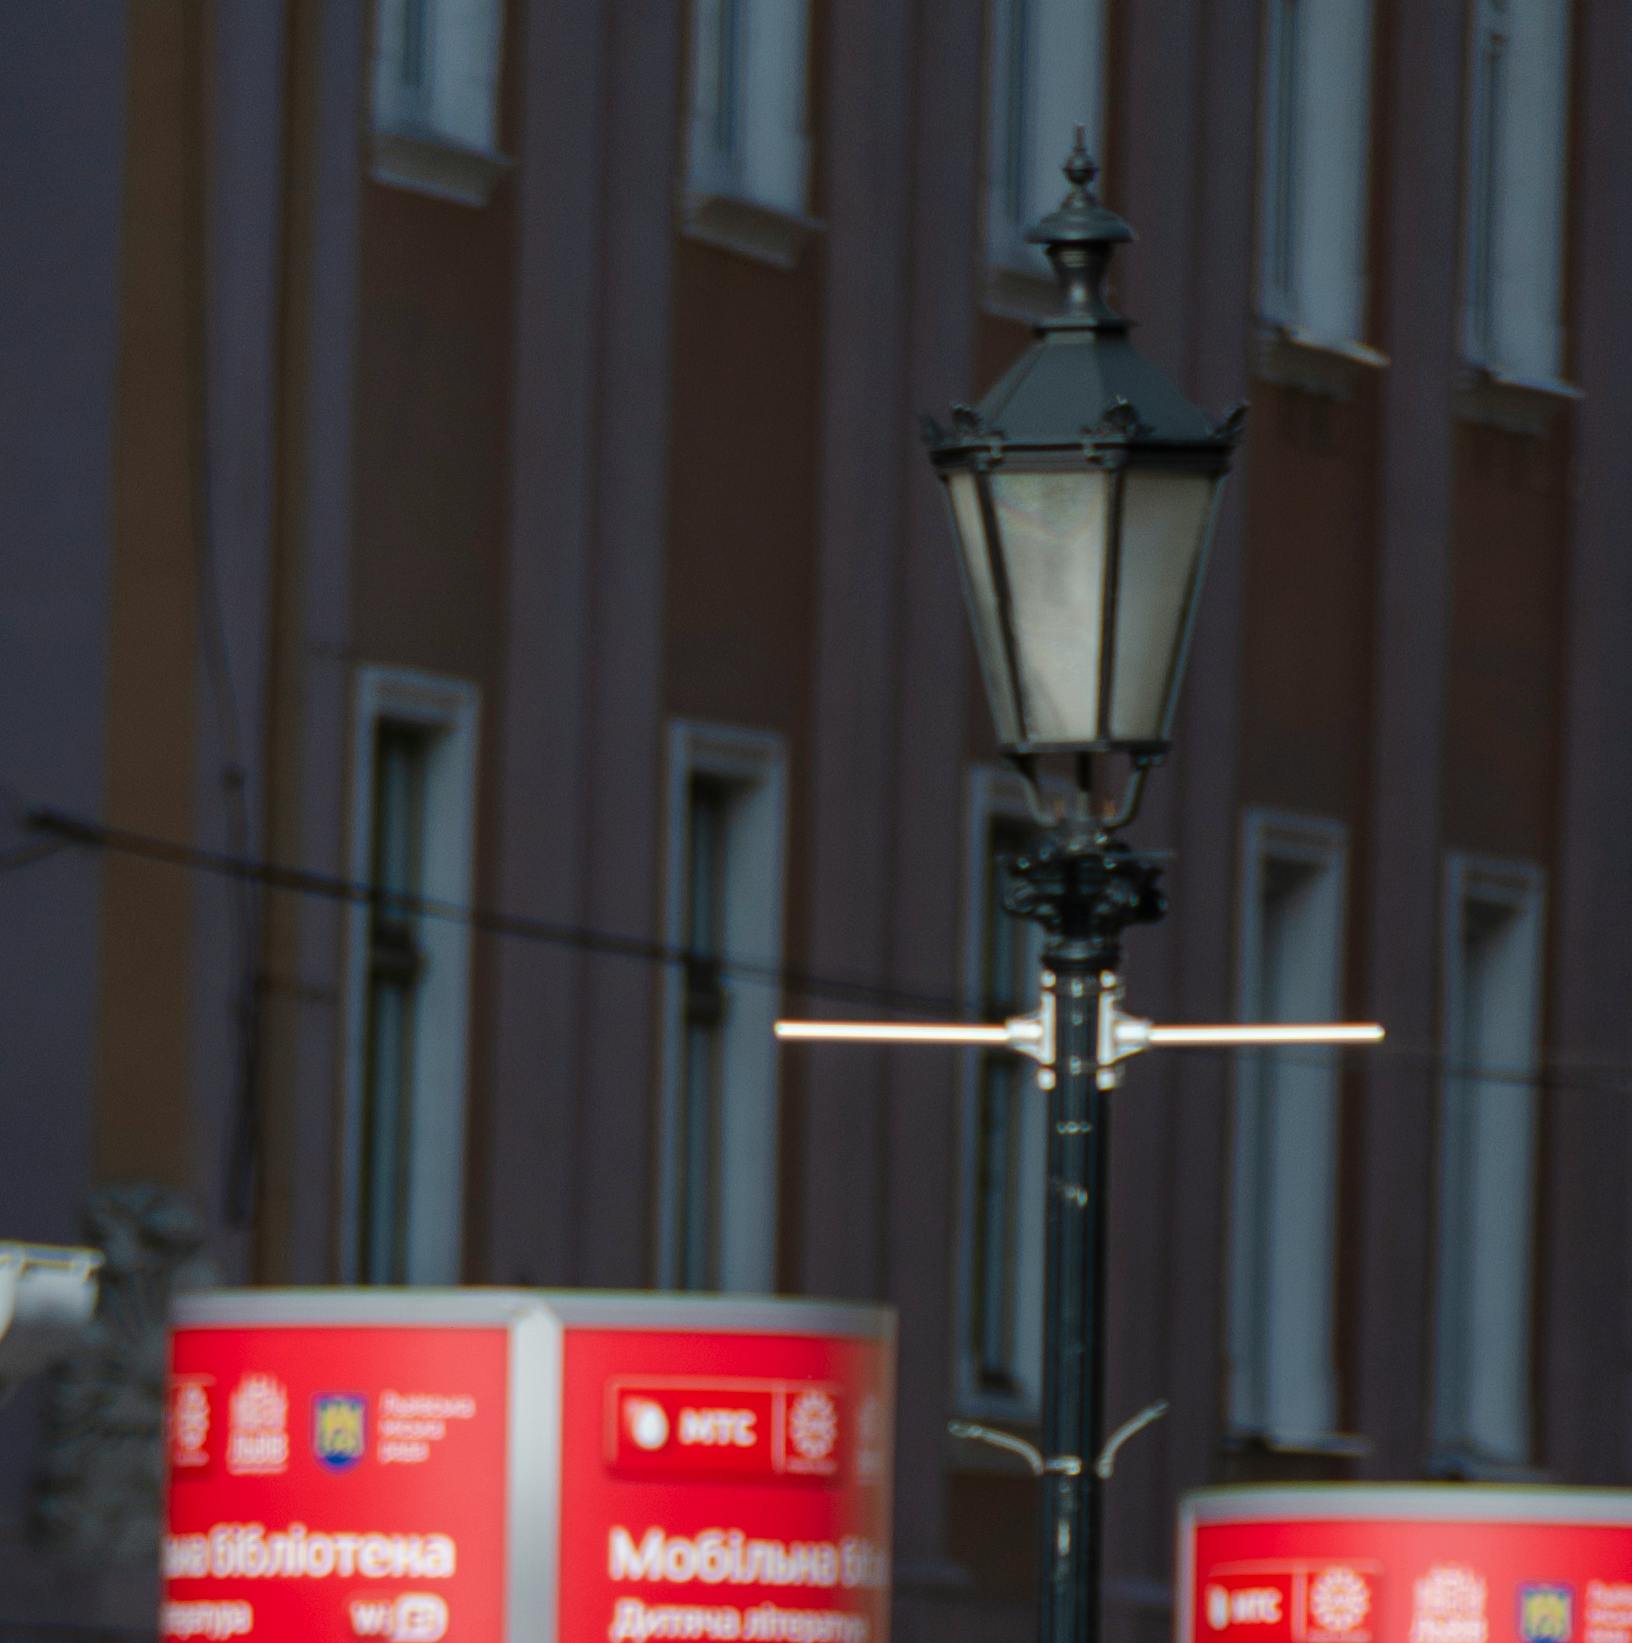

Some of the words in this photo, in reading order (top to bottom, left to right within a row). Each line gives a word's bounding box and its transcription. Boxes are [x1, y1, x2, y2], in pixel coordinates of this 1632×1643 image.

[679, 1407, 756, 1446] МТС
[209, 1522, 457, 1579] бібліотека
[609, 1525, 837, 1587] Мобільна
